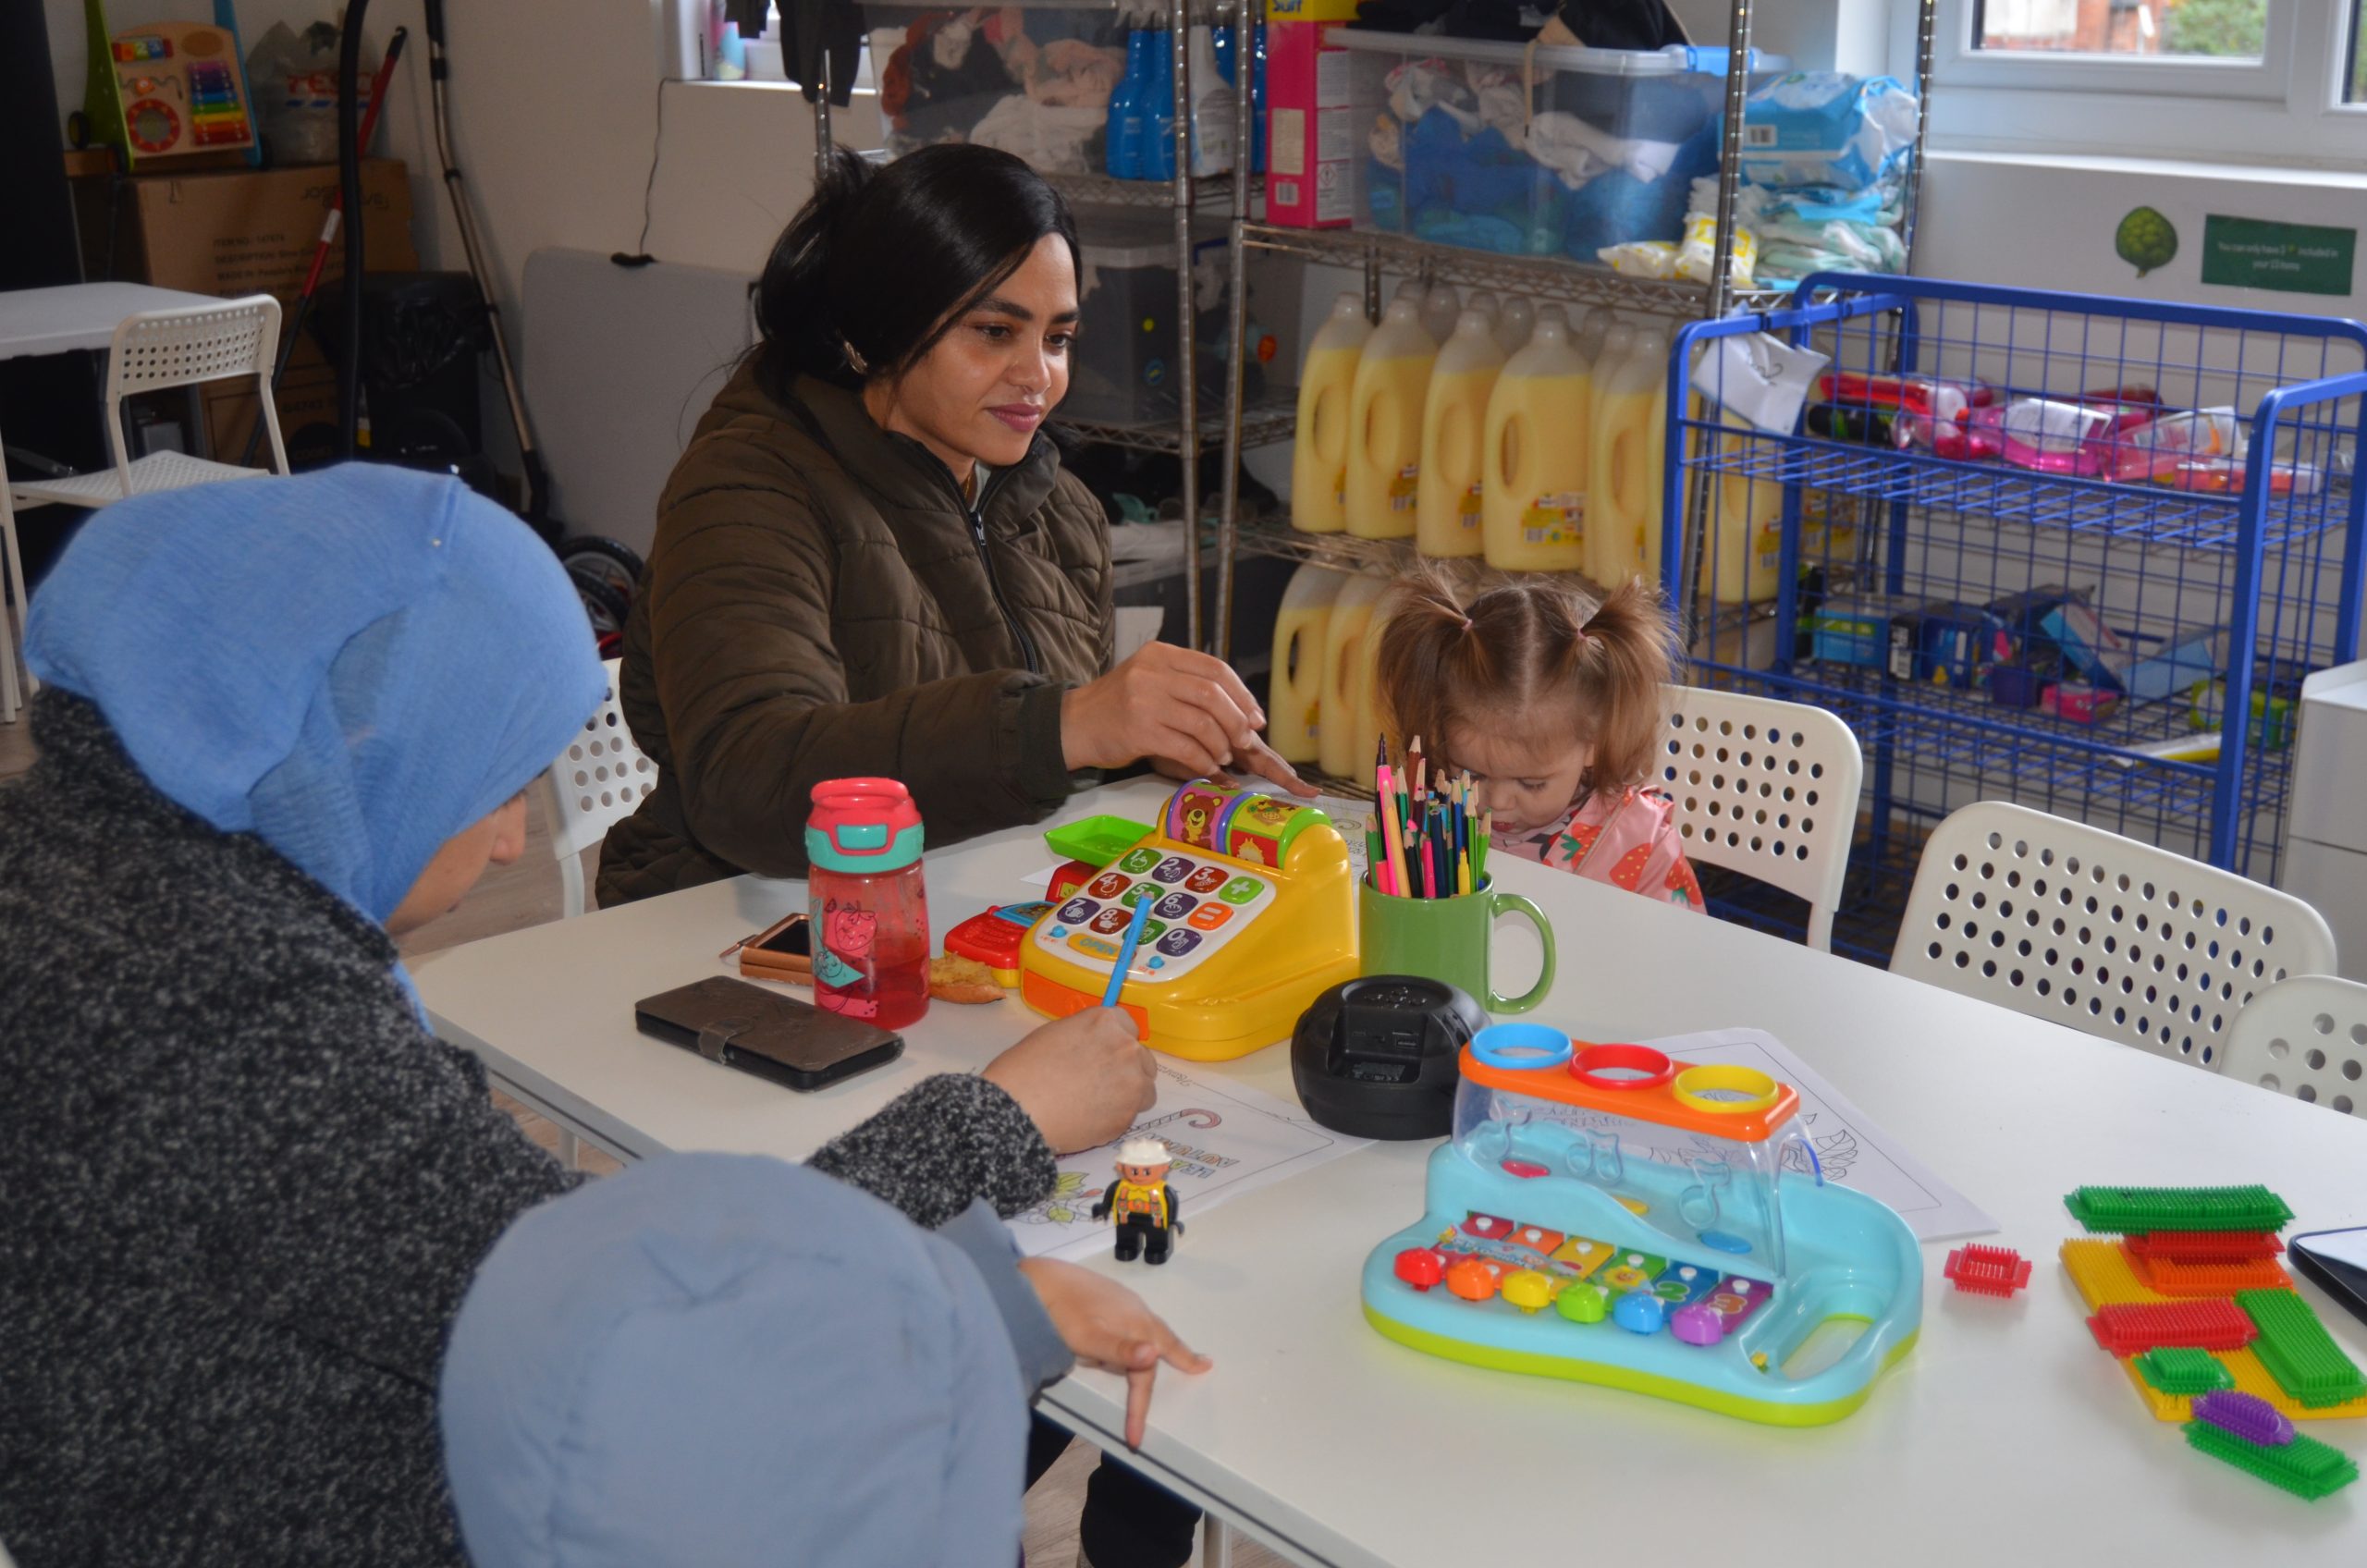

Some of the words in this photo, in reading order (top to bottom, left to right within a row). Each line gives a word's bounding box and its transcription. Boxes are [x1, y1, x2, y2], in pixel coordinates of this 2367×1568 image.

[1130, 848, 1143, 861] 1
[1159, 858, 1176, 870] 2
[1100, 873, 1114, 885] 4
[1195, 868, 1209, 880] 3
[1132, 884, 1148, 896] 5
[1070, 898, 1087, 911] 7
[1164, 893, 1183, 905] 6
[1101, 908, 1114, 921] 8
[1168, 929, 1184, 941] 0
[1079, 937, 1118, 955] OPEN
[1652, 1280, 1691, 1302] 2
[1707, 1293, 1748, 1315] 3
